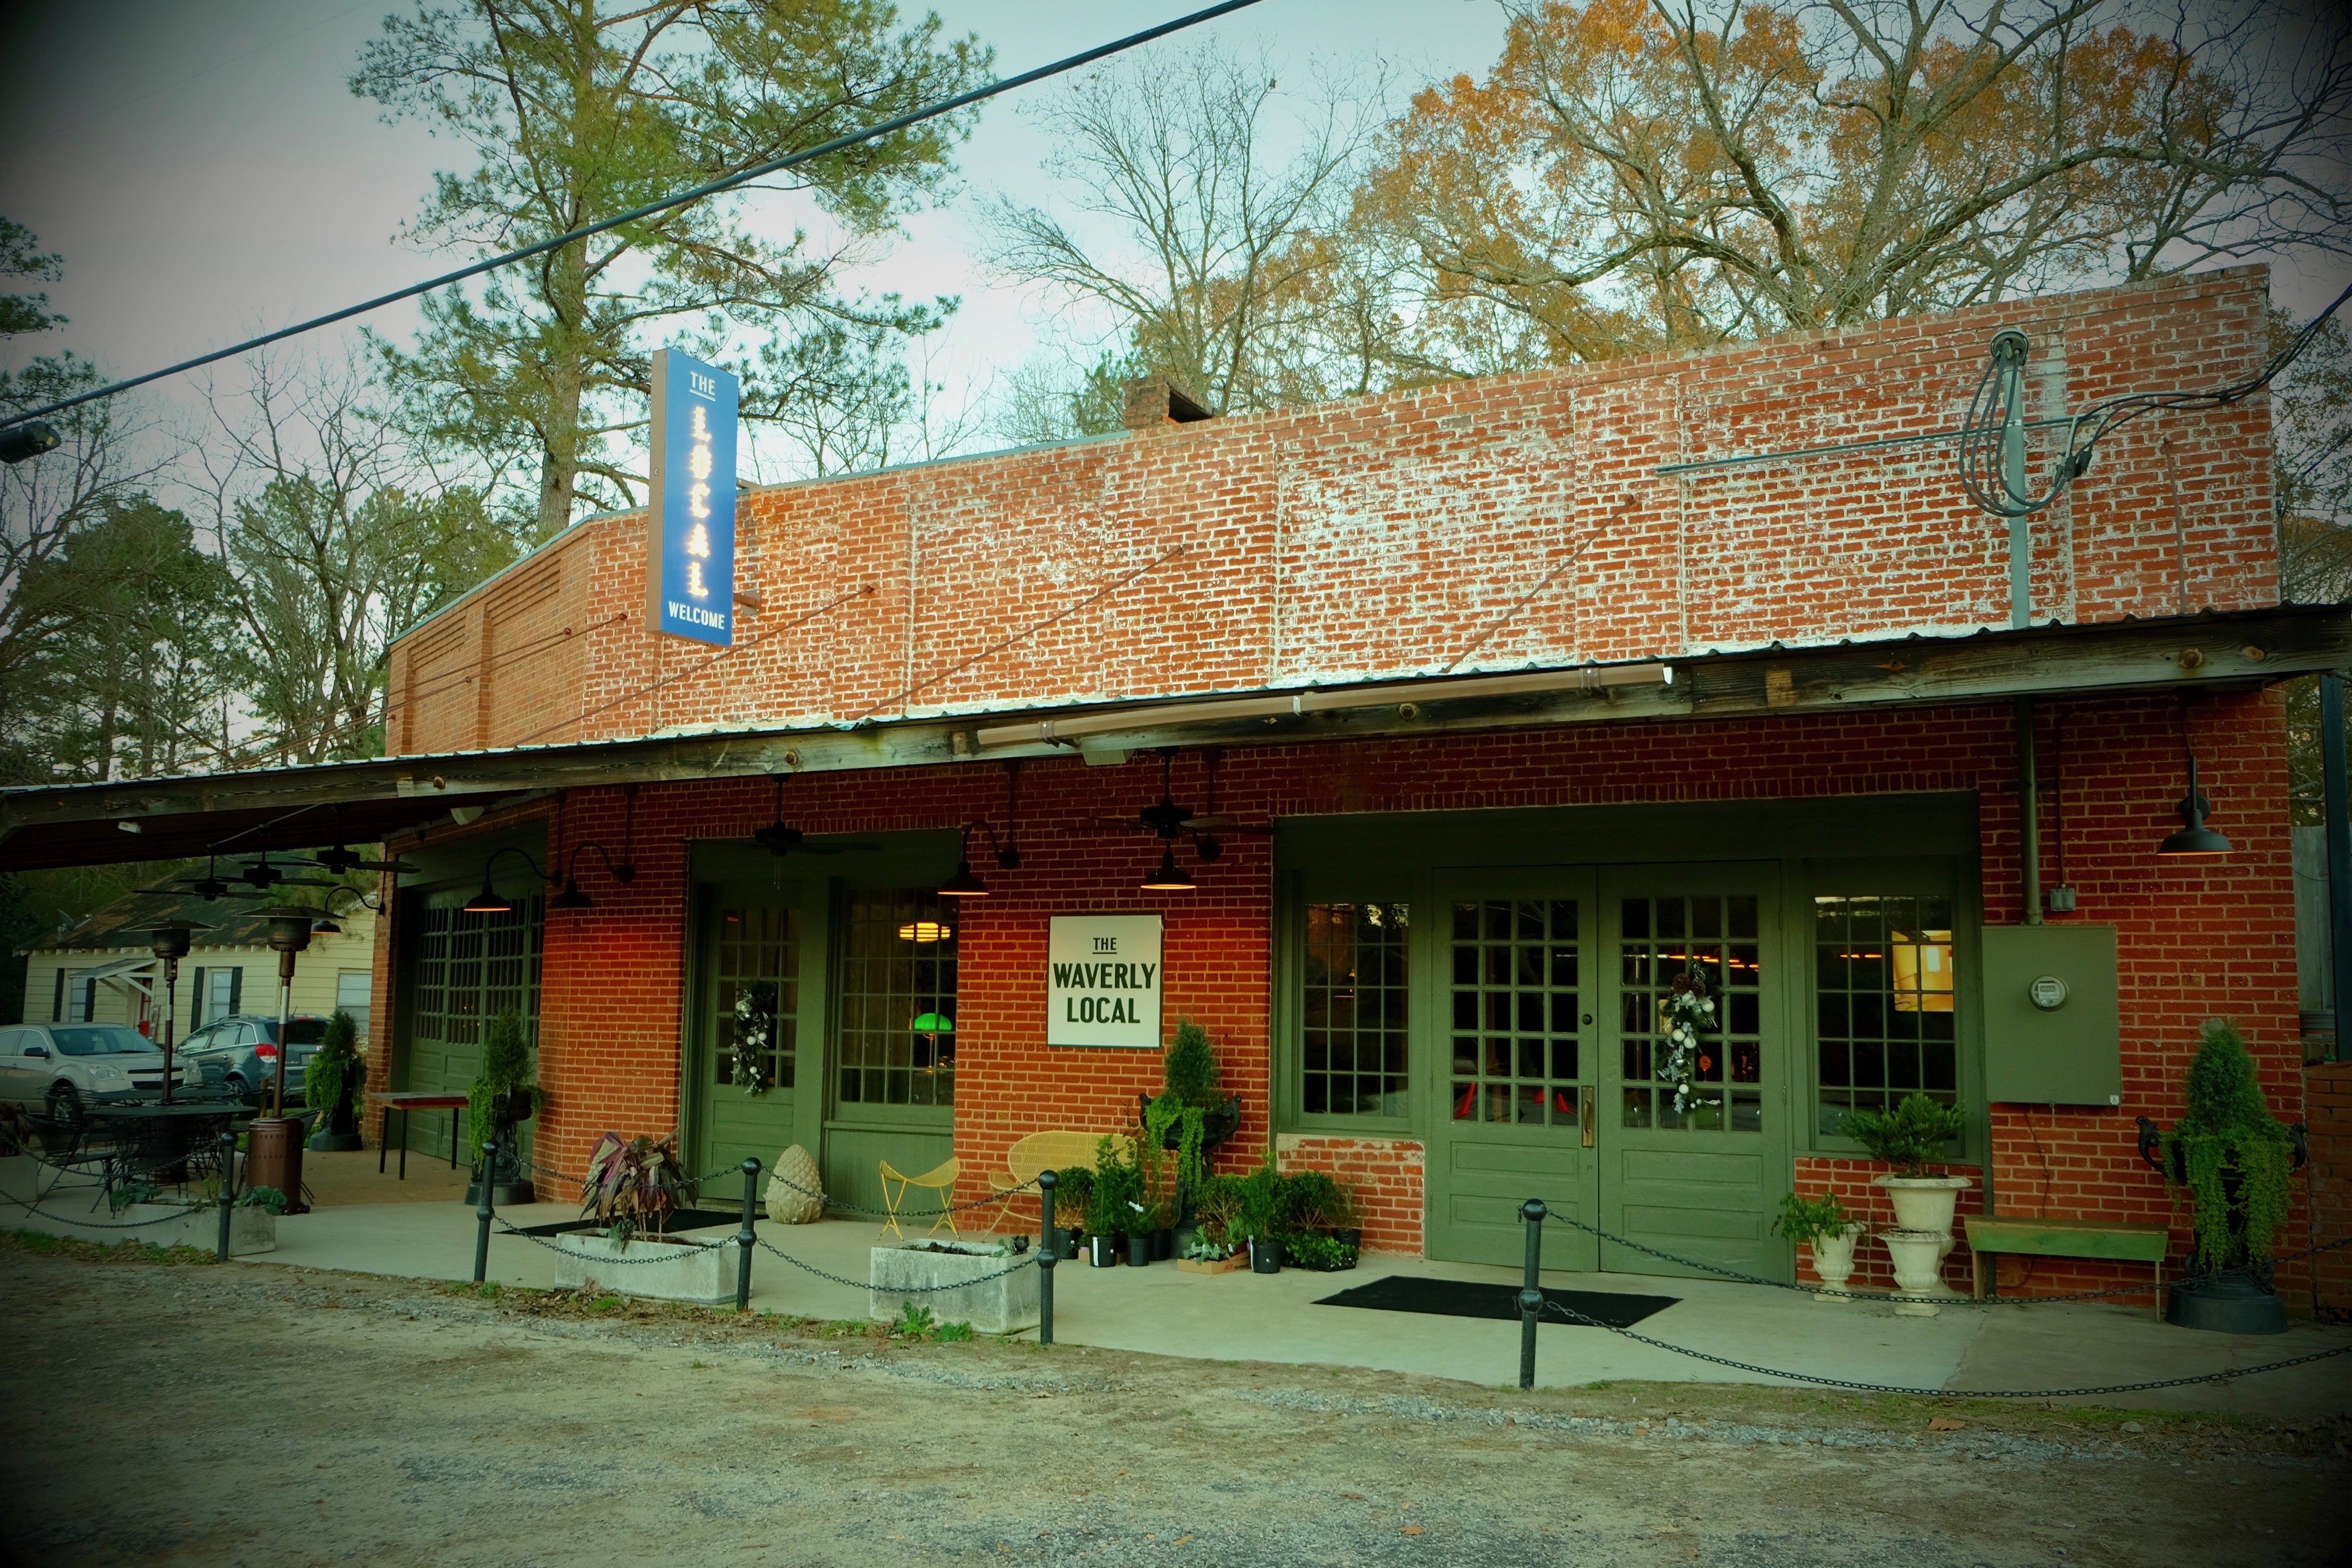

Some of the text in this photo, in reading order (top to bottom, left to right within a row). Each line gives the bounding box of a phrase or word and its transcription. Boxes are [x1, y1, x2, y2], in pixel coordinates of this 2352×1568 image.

[690, 371, 715, 396] THE
[687, 405, 713, 597] LOCAL
[668, 601, 725, 630] WELCOME
[1093, 938, 1117, 950] THE
[1053, 963, 1156, 989] WAVERLY
[1067, 997, 1140, 1023] LOCAL
